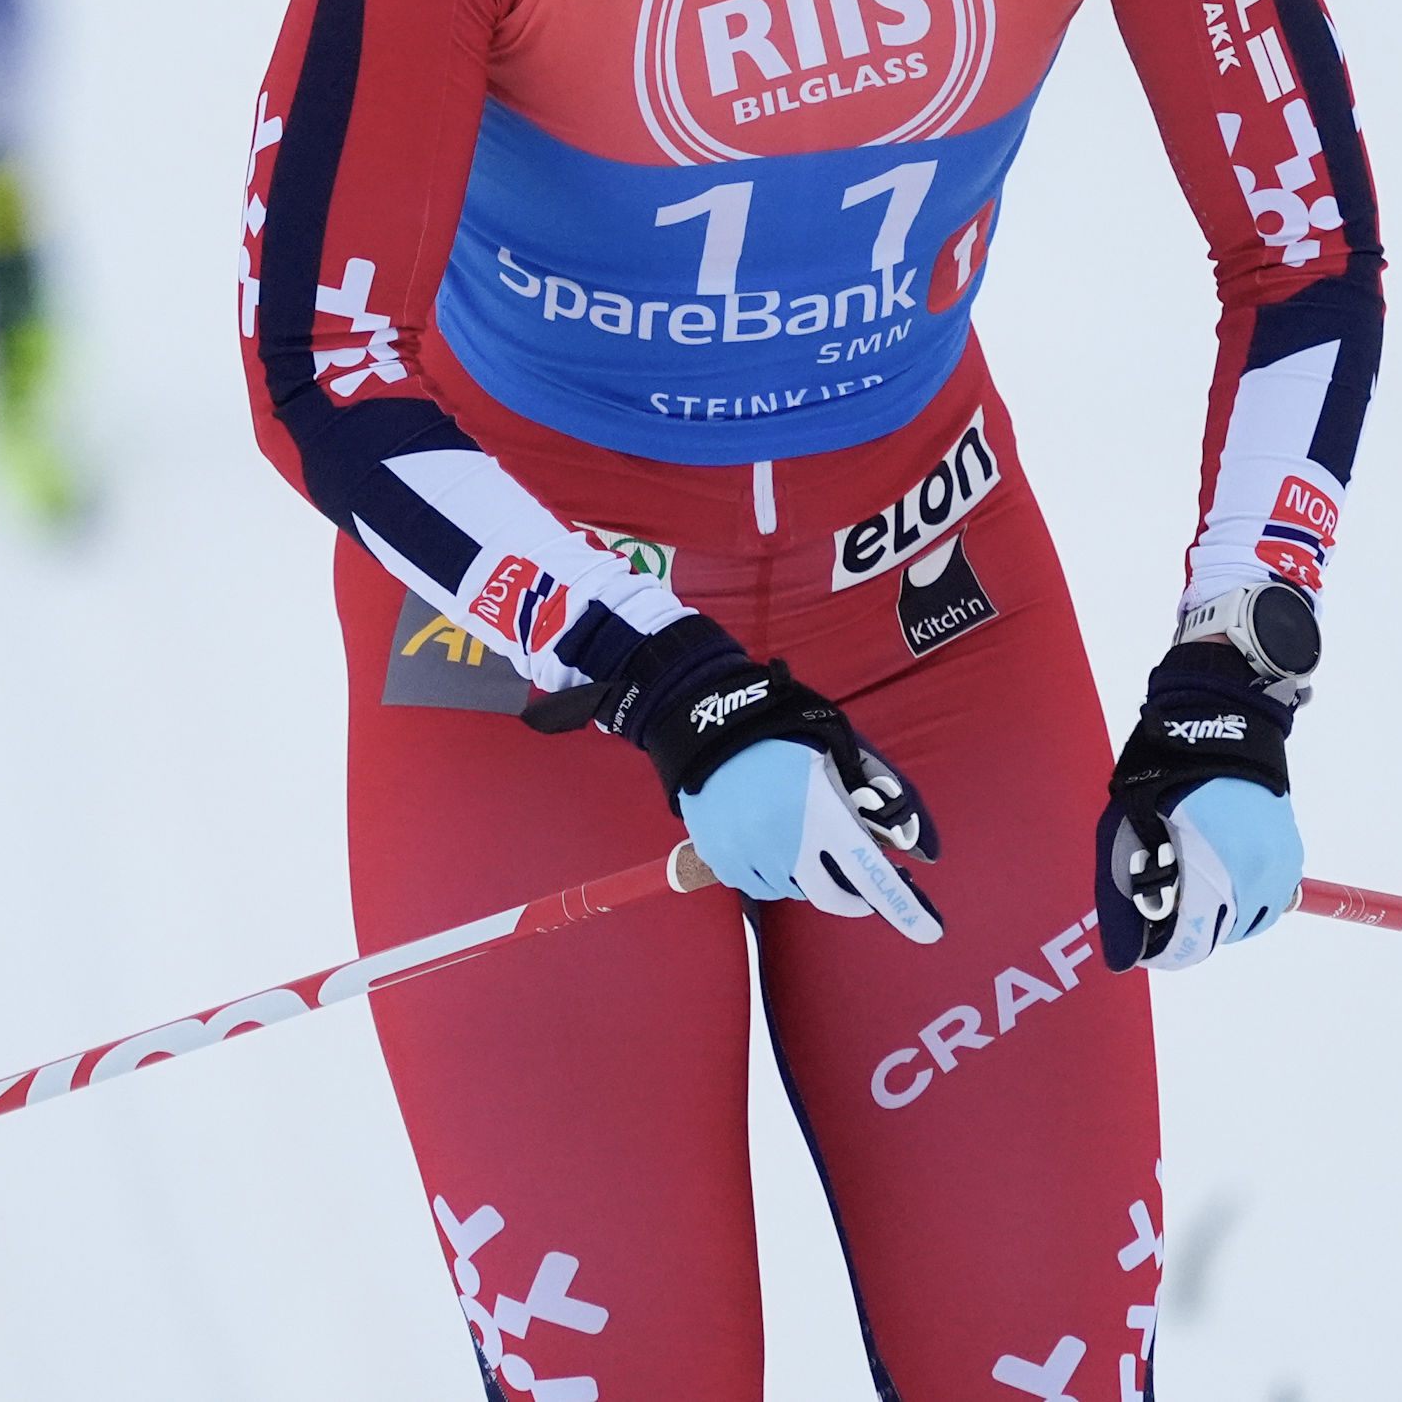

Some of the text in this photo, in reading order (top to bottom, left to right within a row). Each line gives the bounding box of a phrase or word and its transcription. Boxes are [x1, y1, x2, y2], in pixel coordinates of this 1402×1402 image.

[732, 52, 929, 125] BILGLASS
[497, 246, 917, 344] SpareBank
[816, 318, 912, 364] SMN
[1285, 484, 1336, 536] NOR
[910, 598, 985, 645] Kitch'n
[851, 848, 908, 913] AUCLAIR
